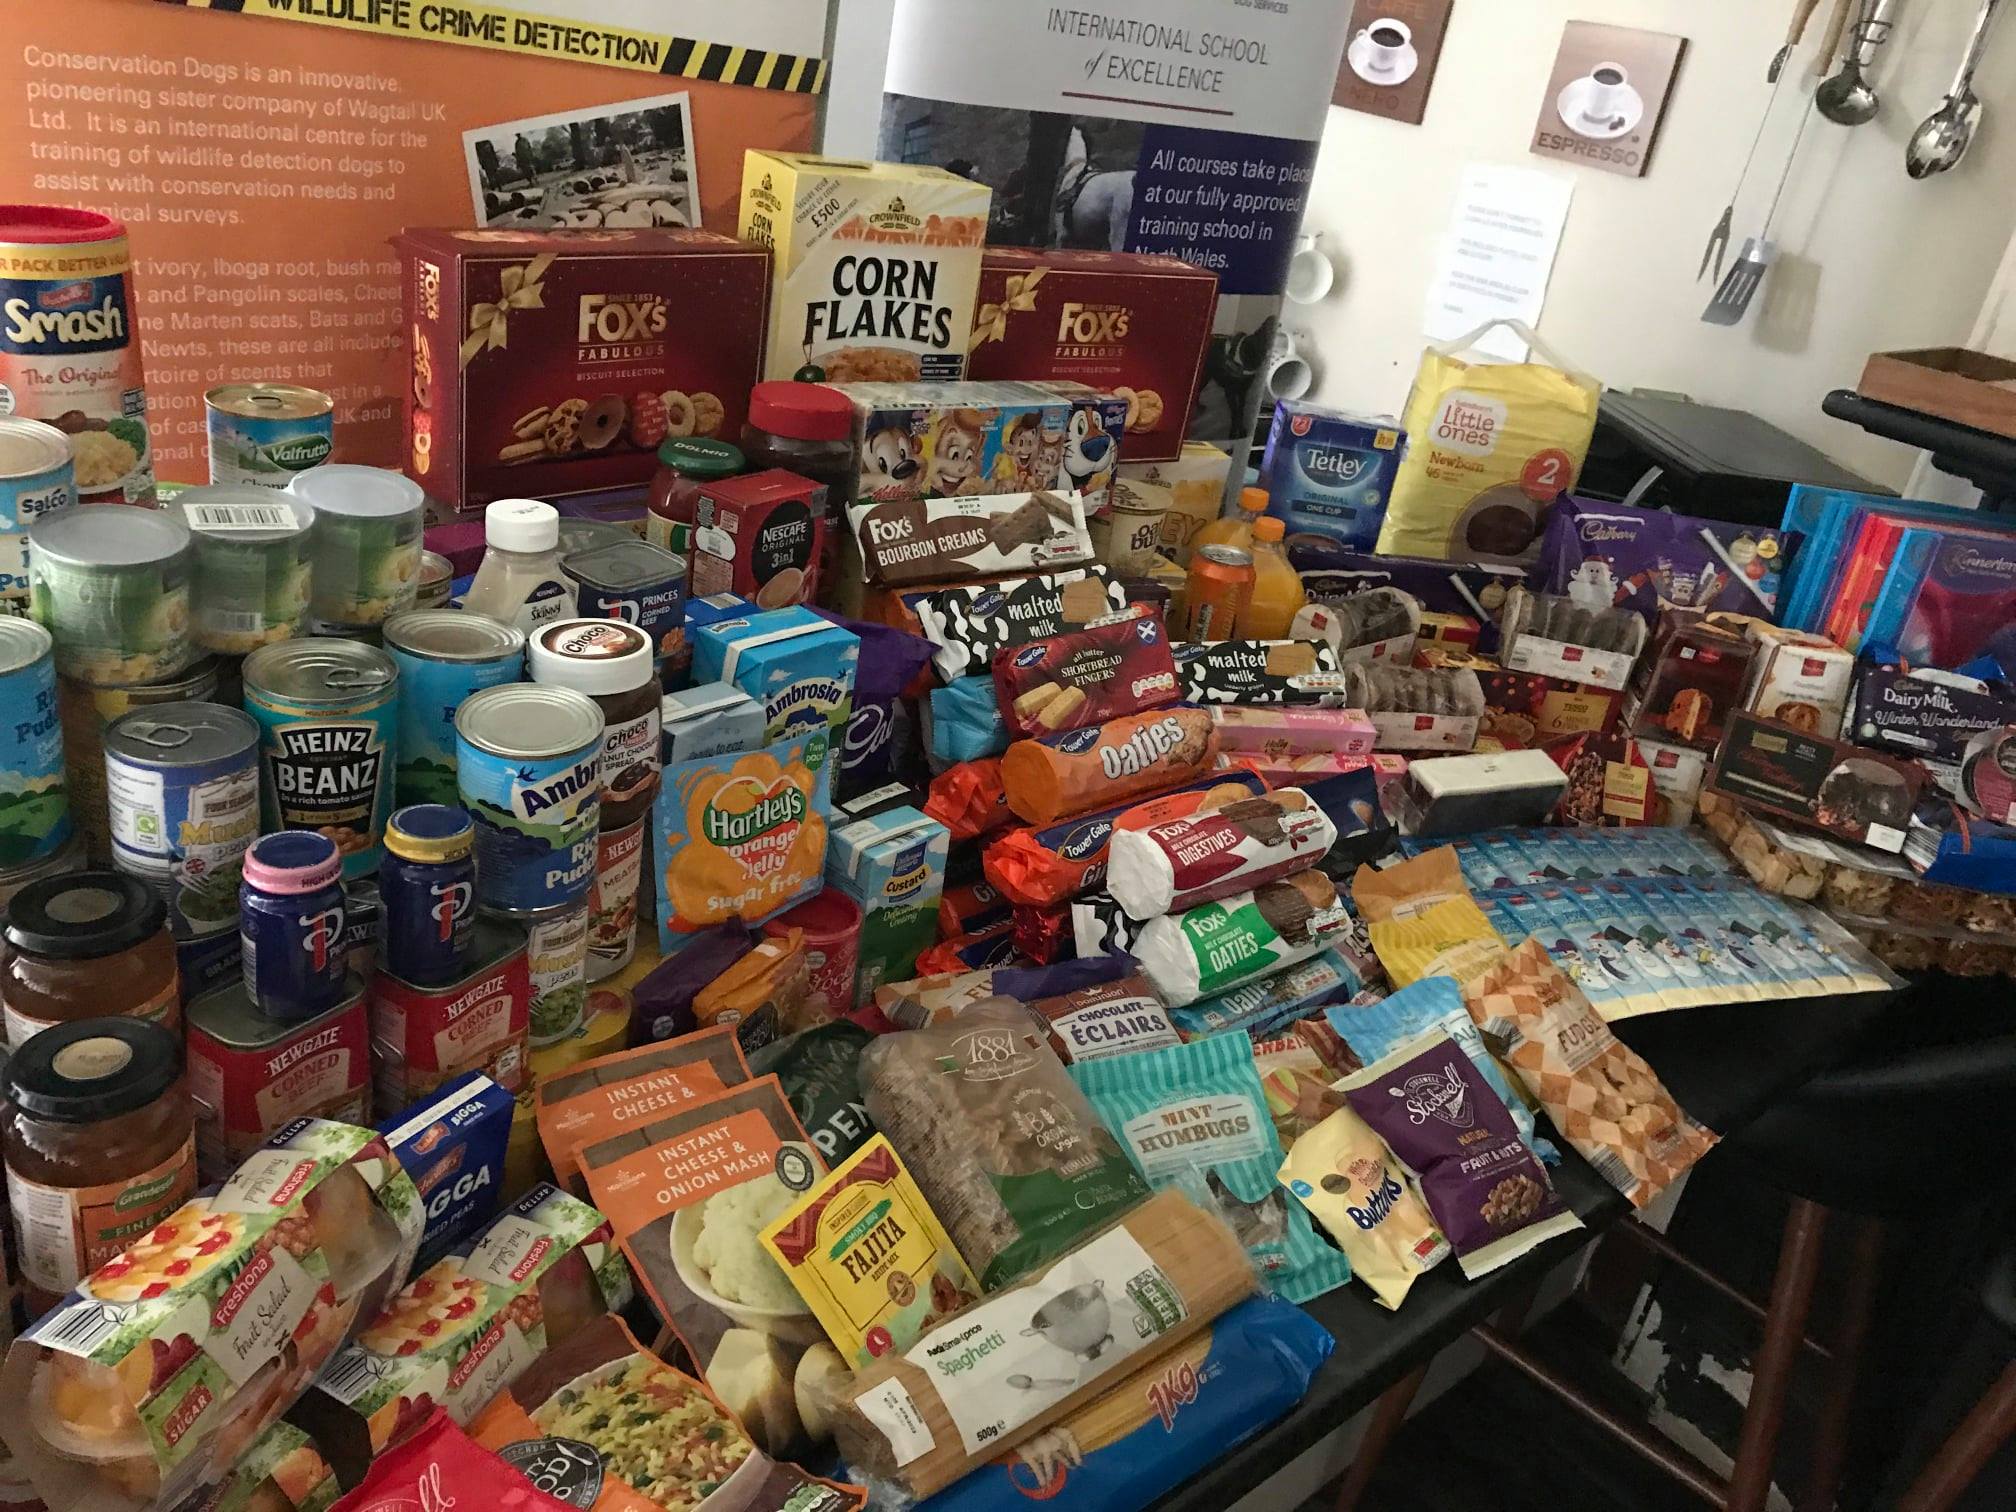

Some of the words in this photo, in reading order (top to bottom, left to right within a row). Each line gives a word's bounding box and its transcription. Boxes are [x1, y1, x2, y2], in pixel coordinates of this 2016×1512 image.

[420, 5, 506, 42] CRIME
[514, 18, 659, 66] DETECTION
[1048, 8, 1192, 53] INTERNATIONAL
[1199, 32, 1270, 65] SCHOOL
[23, 45, 177, 77] Conservation
[184, 57, 238, 84] Dogs
[244, 62, 261, 83] is
[268, 67, 293, 84] an
[1107, 56, 1224, 93] EXCELLENCE
[26, 80, 151, 108] pioneering
[159, 88, 215, 108] sister
[223, 96, 315, 119] company
[323, 98, 345, 117] of
[347, 100, 414, 123] Wagtail
[422, 103, 446, 121] UK
[29, 108, 72, 131] Ltd.
[87, 113, 102, 131] It
[110, 113, 126, 133] is
[135, 117, 161, 134] an
[168, 119, 299, 142] international
[305, 127, 365, 147] centre
[372, 129, 395, 147] for
[401, 130, 427, 148] the
[31, 141, 120, 168] training
[128, 145, 152, 165] of
[157, 147, 234, 168] wildlife
[241, 152, 332, 172] detection
[339, 158, 383, 178] dogs
[390, 159, 405, 175] to
[1537, 132, 1639, 168] ESPRESSO
[1151, 149, 1174, 171] All
[1178, 156, 1237, 177] courses
[1242, 160, 1275, 180] take
[34, 172, 100, 192] assist
[107, 174, 154, 193] with
[162, 177, 295, 198] conservation
[302, 180, 357, 200] needs
[364, 183, 395, 200] and
[1145, 185, 1161, 203] at
[1165, 188, 1191, 205] our
[1197, 185, 1229, 209] fully
[159, 205, 244, 227] surveys.
[753, 213, 772, 232] CORN
[811, 198, 840, 228] £500
[869, 213, 921, 226] CROWNFIELD
[748, 227, 776, 250] FLAKES
[1139, 216, 1199, 241] training
[1203, 220, 1254, 240] school
[1259, 224, 1273, 241] in
[12, 259, 52, 272] PACK
[58, 257, 106, 272] BETTER
[149, 259, 207, 281] ivory,
[214, 258, 269, 277] Iboga
[276, 261, 320, 278] root,
[327, 258, 371, 276] bush
[1182, 246, 1229, 269] Wales.
[832, 255, 938, 301] CORN
[149, 285, 188, 302] and
[194, 284, 281, 306] Pangolin
[289, 287, 348, 303] scales,
[5, 295, 124, 343] Smash
[171, 312, 243, 330] Marten
[250, 311, 301, 331] scats,
[310, 311, 349, 327] Bats
[355, 309, 385, 326] and
[802, 300, 952, 349] FLAKES
[220, 338, 271, 355] these
[278, 341, 308, 354] are
[314, 337, 334, 353] all
[578, 344, 665, 361] FABULOUS
[1056, 346, 1125, 358] FABULOUS
[21, 368, 54, 385] The
[207, 365, 224, 381] of
[231, 365, 291, 380] scents
[298, 363, 333, 377] that
[577, 370, 613, 381] BISCUIT
[616, 367, 665, 379] SELECTION
[150, 420, 171, 436] of
[1443, 405, 1494, 431] Little
[1438, 425, 1489, 446] ones
[674, 442, 729, 458] DOLMIO
[1307, 449, 1367, 480] Tetley
[1536, 458, 1560, 485] 2
[1304, 491, 1350, 505] ORIGINAL
[1306, 504, 1324, 513] ONE
[1325, 505, 1342, 515] CUP
[762, 536, 806, 552] ORIGINAL
[1580, 521, 1637, 542] Cadbury
[771, 548, 794, 569] 3in1
[876, 538, 938, 567] BOURBON
[938, 528, 988, 553] CREAMS
[642, 588, 678, 607] PRINCES
[970, 600, 989, 616] Tower
[1008, 592, 1063, 621] malted
[642, 606, 670, 619] CORNED
[564, 626, 607, 654] Choco
[1028, 620, 1058, 638] milk
[1016, 651, 1032, 668] Tower
[1031, 646, 1047, 661] Gate
[1061, 654, 1123, 678] SHORTBREAD
[1082, 648, 1105, 661] butter
[1208, 651, 1267, 669] malted
[1074, 667, 1116, 687] FINGERS
[1227, 669, 1257, 683] milk
[765, 679, 844, 722] Ambrosia
[1884, 688, 1922, 710] Dairy
[1923, 686, 1953, 713] Milk
[606, 717, 649, 750] Choco
[1875, 711, 1919, 725] Winter
[1920, 712, 2000, 729] Wonderland
[288, 732, 366, 755] HEINZ
[1060, 736, 1083, 754] Tower
[1080, 727, 1100, 744] Gate
[1099, 715, 1186, 780] Oaties
[278, 758, 375, 795] BEANZ
[605, 758, 635, 771] SPREAD
[299, 797, 315, 805] rich
[318, 795, 350, 804] tomato
[709, 786, 802, 841] Hartley's
[729, 828, 799, 859] orange
[1064, 834, 1093, 858] Tower
[1091, 822, 1112, 841] Gate
[1176, 829, 1237, 867] DIGESTIVES
[302, 875, 326, 888] HIGH
[886, 869, 926, 892] Custard
[706, 883, 765, 912] Sugar
[1205, 939, 1218, 950] MILK
[1218, 927, 1243, 944] CHOCOLATE
[1209, 932, 1260, 974] OATIES
[443, 974, 508, 1022] NEWGATE
[447, 999, 504, 1043] CORNED
[1077, 1001, 1144, 1023] CHOCOLATE
[1070, 1015, 1167, 1047] ÉCLAIRS
[265, 1025, 342, 1077] NEWGATE
[967, 1030, 1016, 1064] 1881
[270, 1052, 340, 1098] CORNED
[606, 1072, 681, 1104] INSTANT
[612, 1092, 677, 1121] CHEESE
[682, 1086, 695, 1099] &
[1407, 1062, 1469, 1124] Stockwell
[450, 1101, 487, 1126] BIGGA
[1160, 1104, 1213, 1127] MINT
[657, 1126, 732, 1163] INSTANT
[1137, 1115, 1250, 1154] HUMBUGS
[663, 1145, 727, 1182] CHEESE
[733, 1140, 747, 1154] &
[1460, 1154, 1492, 1173] FRUIT
[271, 1160, 317, 1207] Freshona
[656, 1169, 722, 1205] ONION
[724, 1151, 771, 1178] MASH
[1346, 1172, 1405, 1232] Buttons
[115, 1217, 155, 1237] FINE
[511, 1237, 551, 1282] Freshona
[840, 1215, 907, 1285] FAJITA
[214, 1255, 270, 1328] Freshona
[234, 1322, 261, 1361] Fruit
[255, 1275, 292, 1324] Salad
[452, 1326, 502, 1388] Freshona
[936, 1330, 1006, 1377] Spaghetti
[168, 1393, 209, 1444] SUGAR
[976, 1425, 999, 1444] 500g
